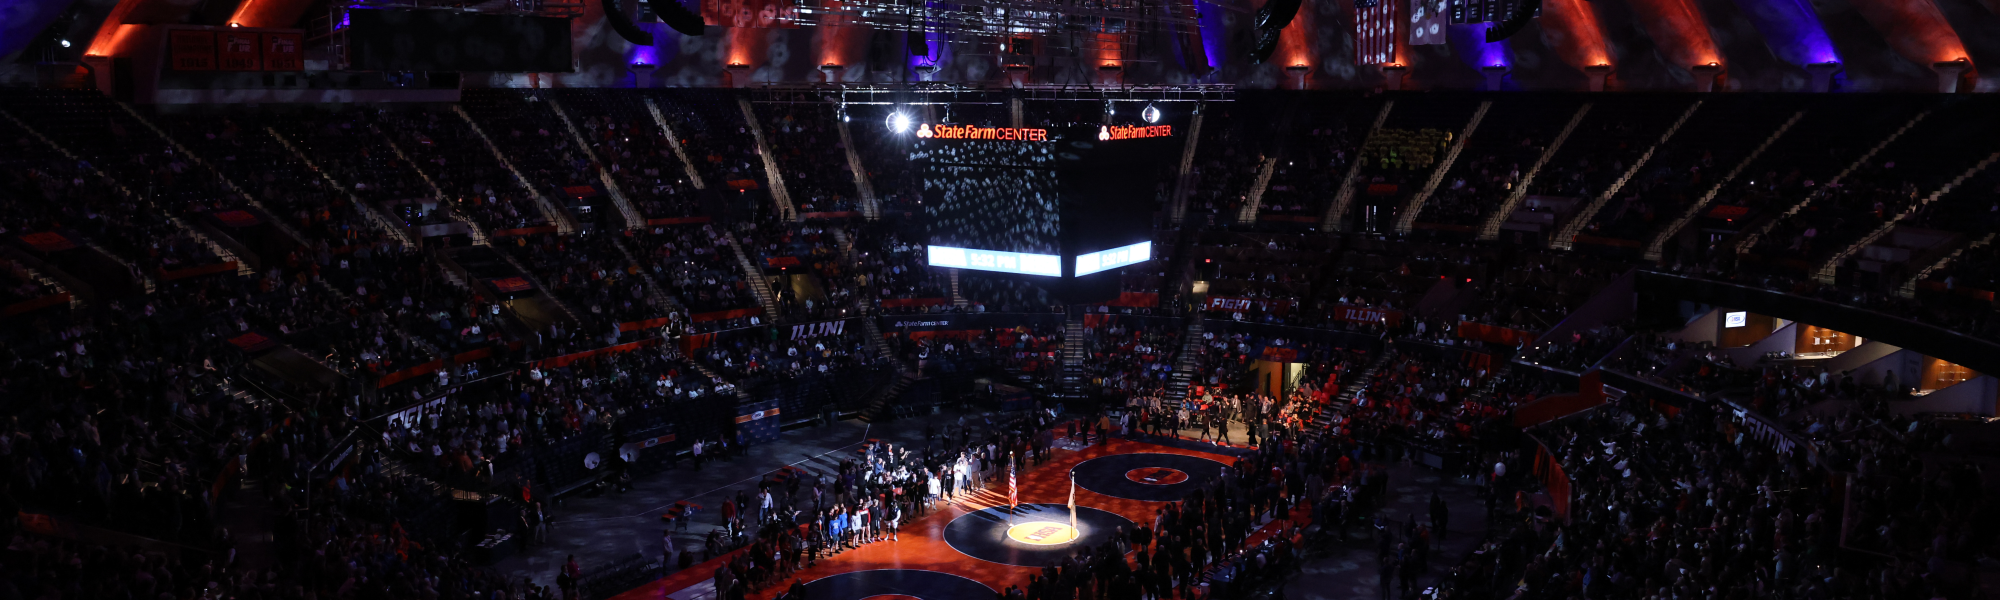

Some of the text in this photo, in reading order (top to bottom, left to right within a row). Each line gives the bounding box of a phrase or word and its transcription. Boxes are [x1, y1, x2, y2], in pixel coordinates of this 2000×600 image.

[996, 127, 1047, 141] CENTER
[1146, 125, 1172, 138] CENTER
[997, 255, 1017, 269] PM
[790, 320, 845, 340] ILLINI
